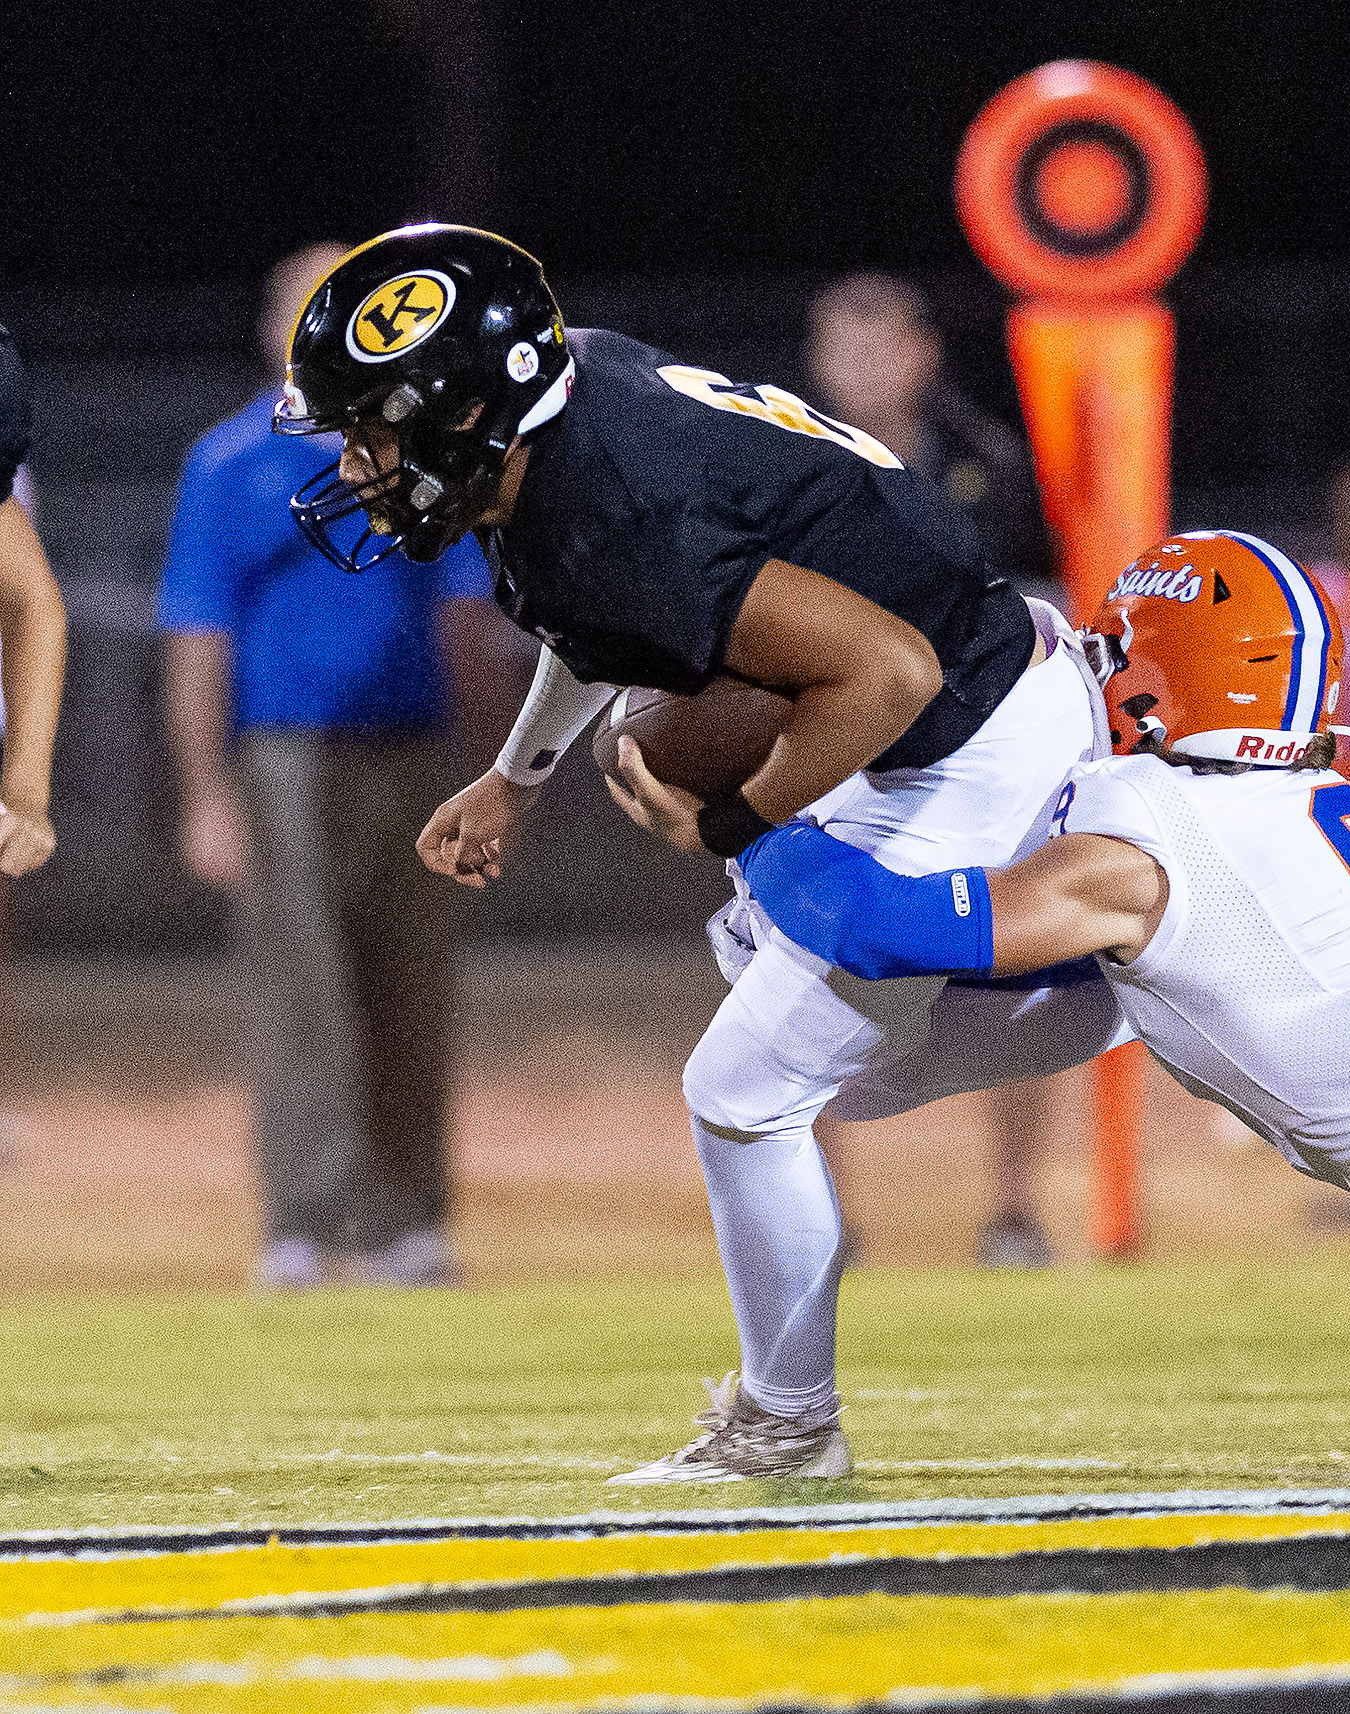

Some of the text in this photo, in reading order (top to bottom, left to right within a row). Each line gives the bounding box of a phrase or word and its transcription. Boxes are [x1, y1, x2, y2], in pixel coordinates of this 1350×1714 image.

[361, 281, 437, 348] K
[1106, 560, 1204, 604] Saints
[1051, 780, 1077, 839] 9
